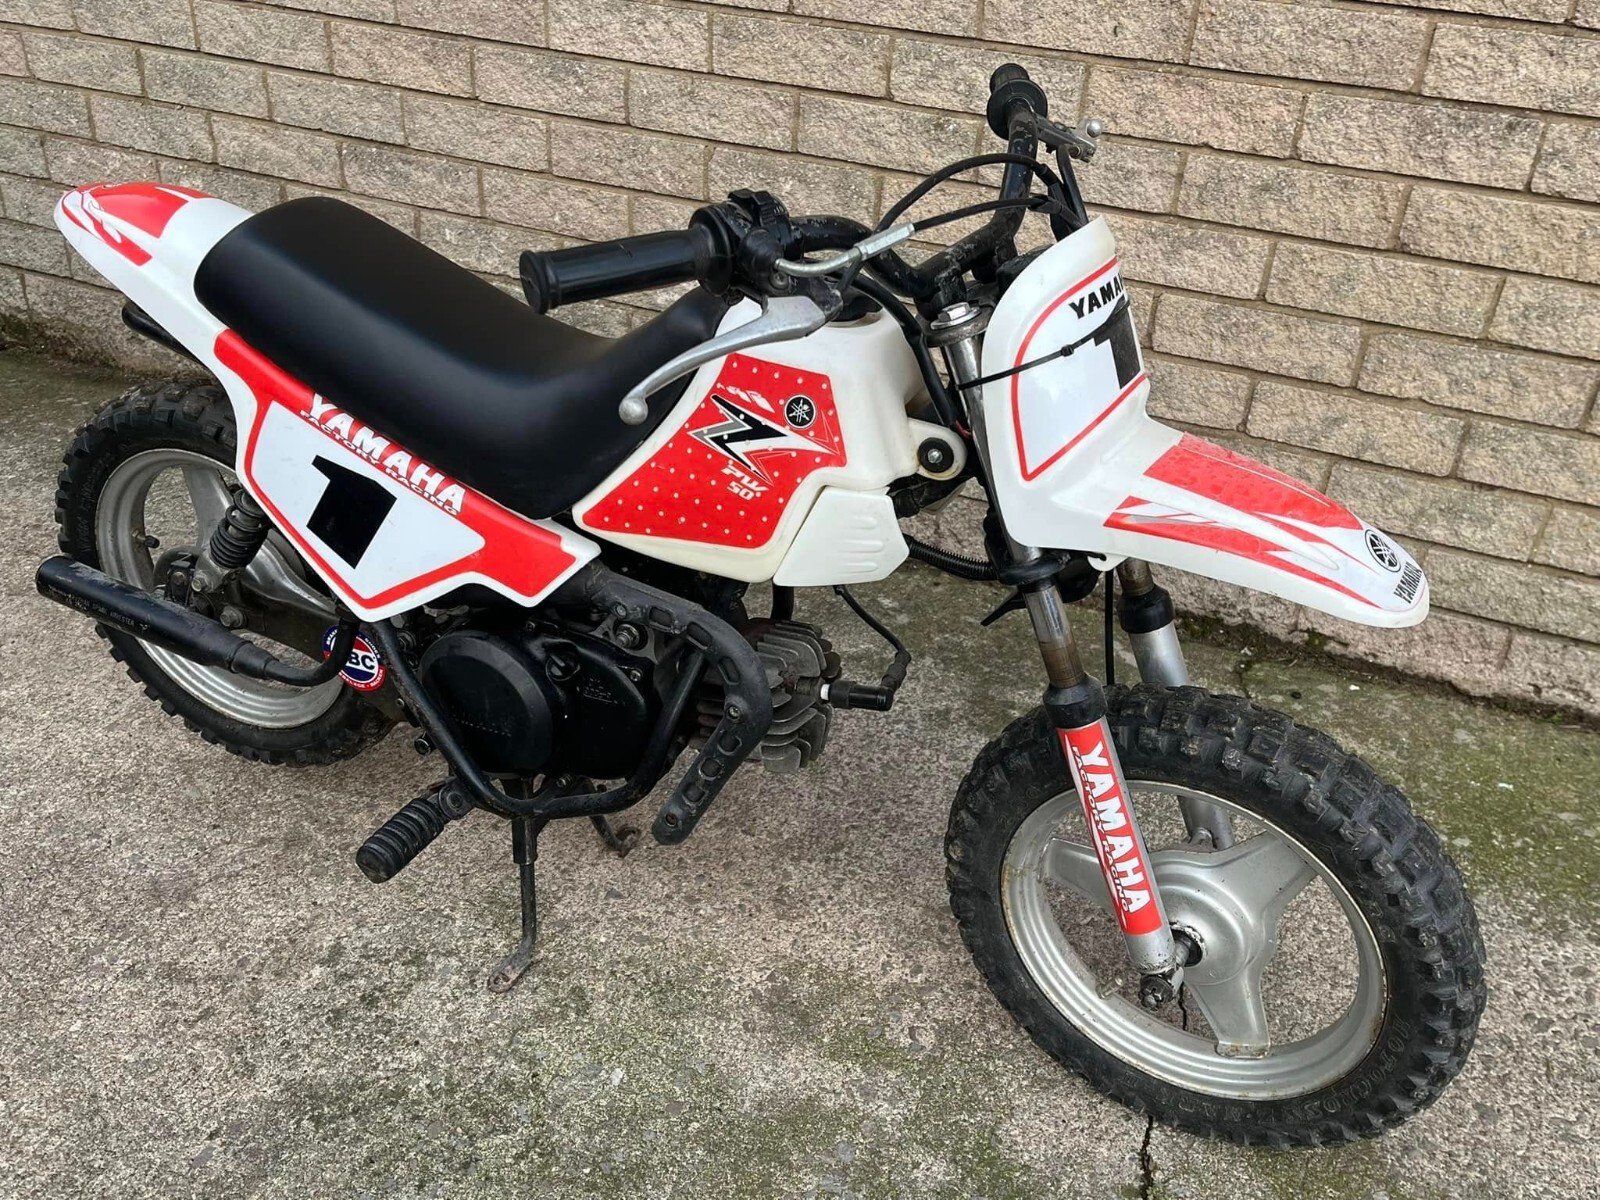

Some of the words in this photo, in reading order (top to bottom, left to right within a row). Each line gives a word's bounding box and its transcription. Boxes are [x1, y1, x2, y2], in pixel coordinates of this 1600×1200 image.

[1094, 295, 1141, 389] 1
[300, 410, 380, 467] FACTORY
[385, 467, 460, 515] RACING
[309, 394, 468, 512] YAMAHA
[721, 465, 769, 492] PW
[727, 481, 754, 501] 50
[306, 454, 397, 569] 1
[1394, 561, 1422, 604] YAMAHA
[348, 652, 375, 670] BC
[1071, 746, 1105, 832] FACTORY
[1102, 840, 1130, 912] RACING
[1081, 740, 1151, 912] YAMAHA
